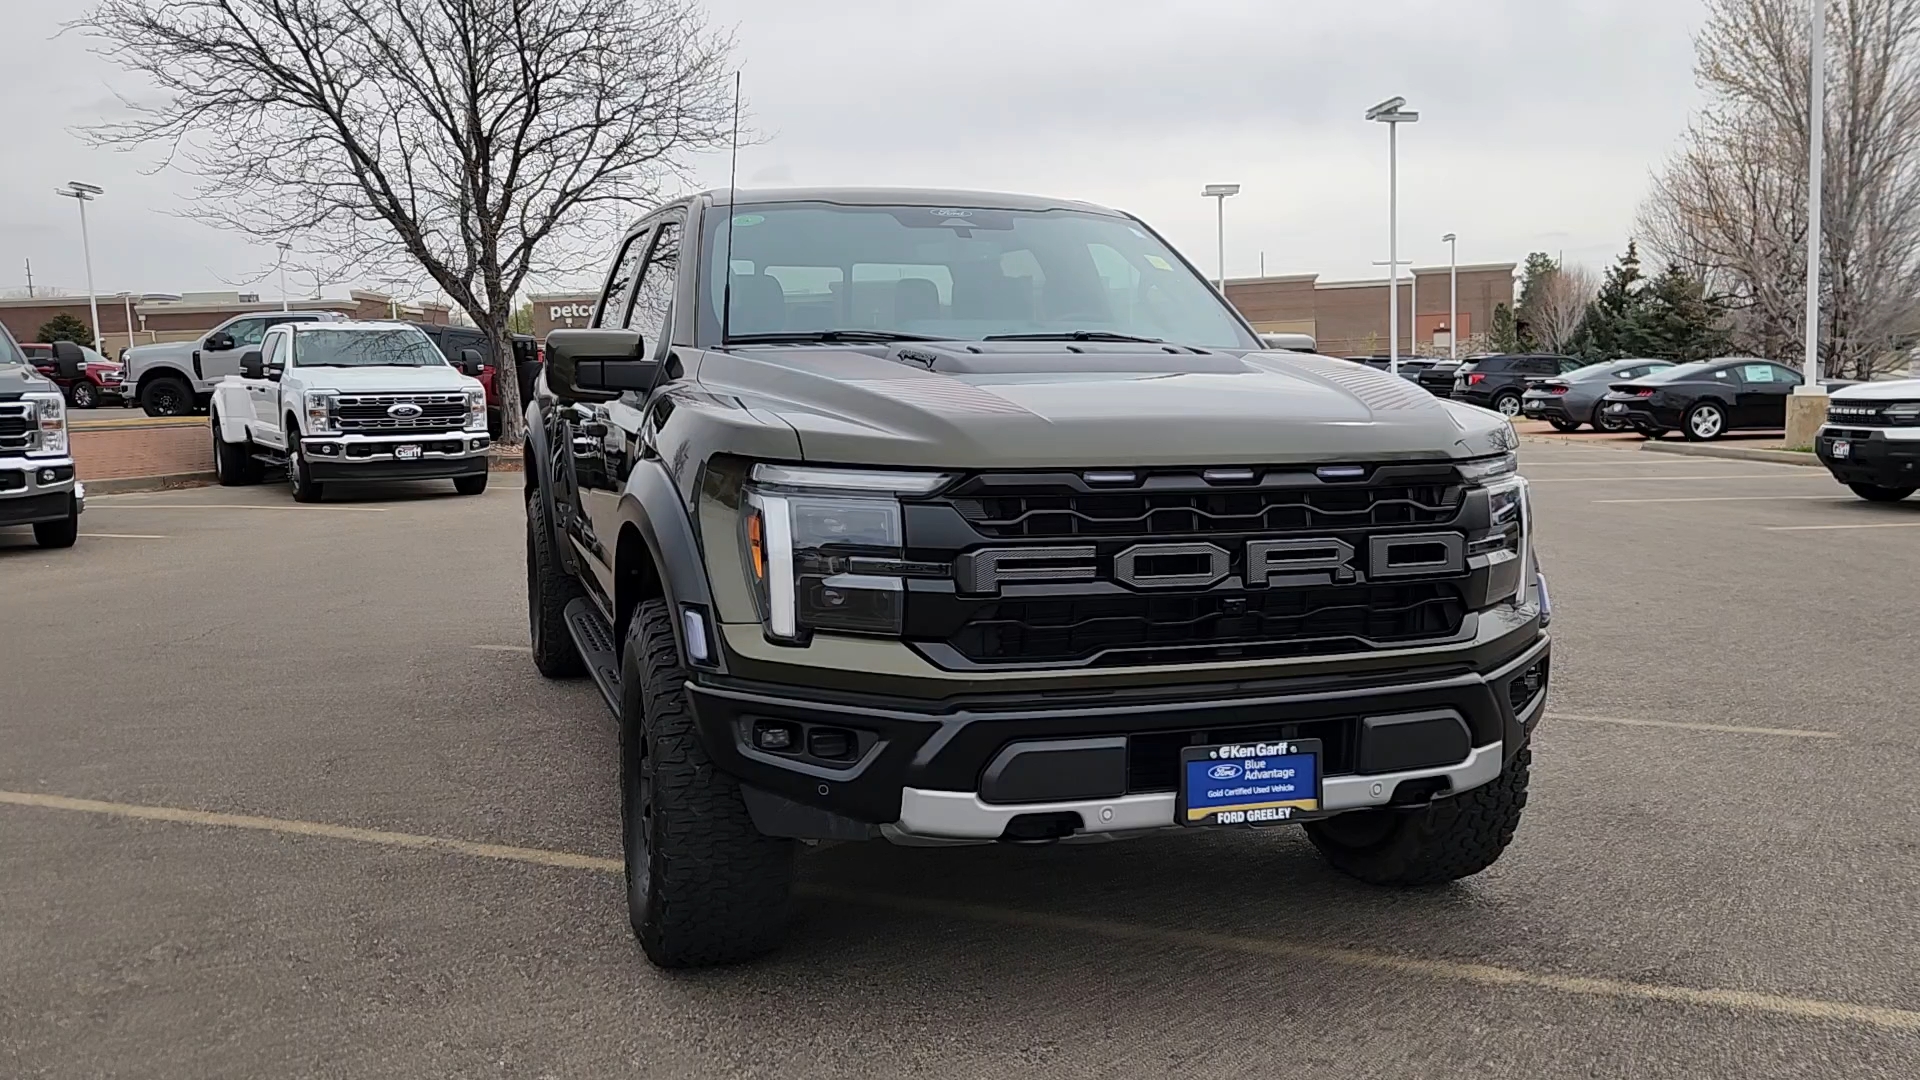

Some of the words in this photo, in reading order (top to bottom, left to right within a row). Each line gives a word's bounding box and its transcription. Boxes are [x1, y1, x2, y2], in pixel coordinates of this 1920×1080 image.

[962, 532, 1465, 596] FORD
[1230, 745, 1255, 759] Ken
[1256, 742, 1288, 756] Garff
[1214, 767, 1236, 776] Ford
[1244, 760, 1266, 770] Blue
[1244, 769, 1295, 780] Advantage
[1207, 789, 1224, 798] Gold
[1224, 787, 1252, 797] Certified
[1253, 786, 1270, 794] Used
[1271, 784, 1295, 793] Vehicle
[1217, 811, 1245, 824] FORD
[1246, 807, 1292, 822] GREELEY
